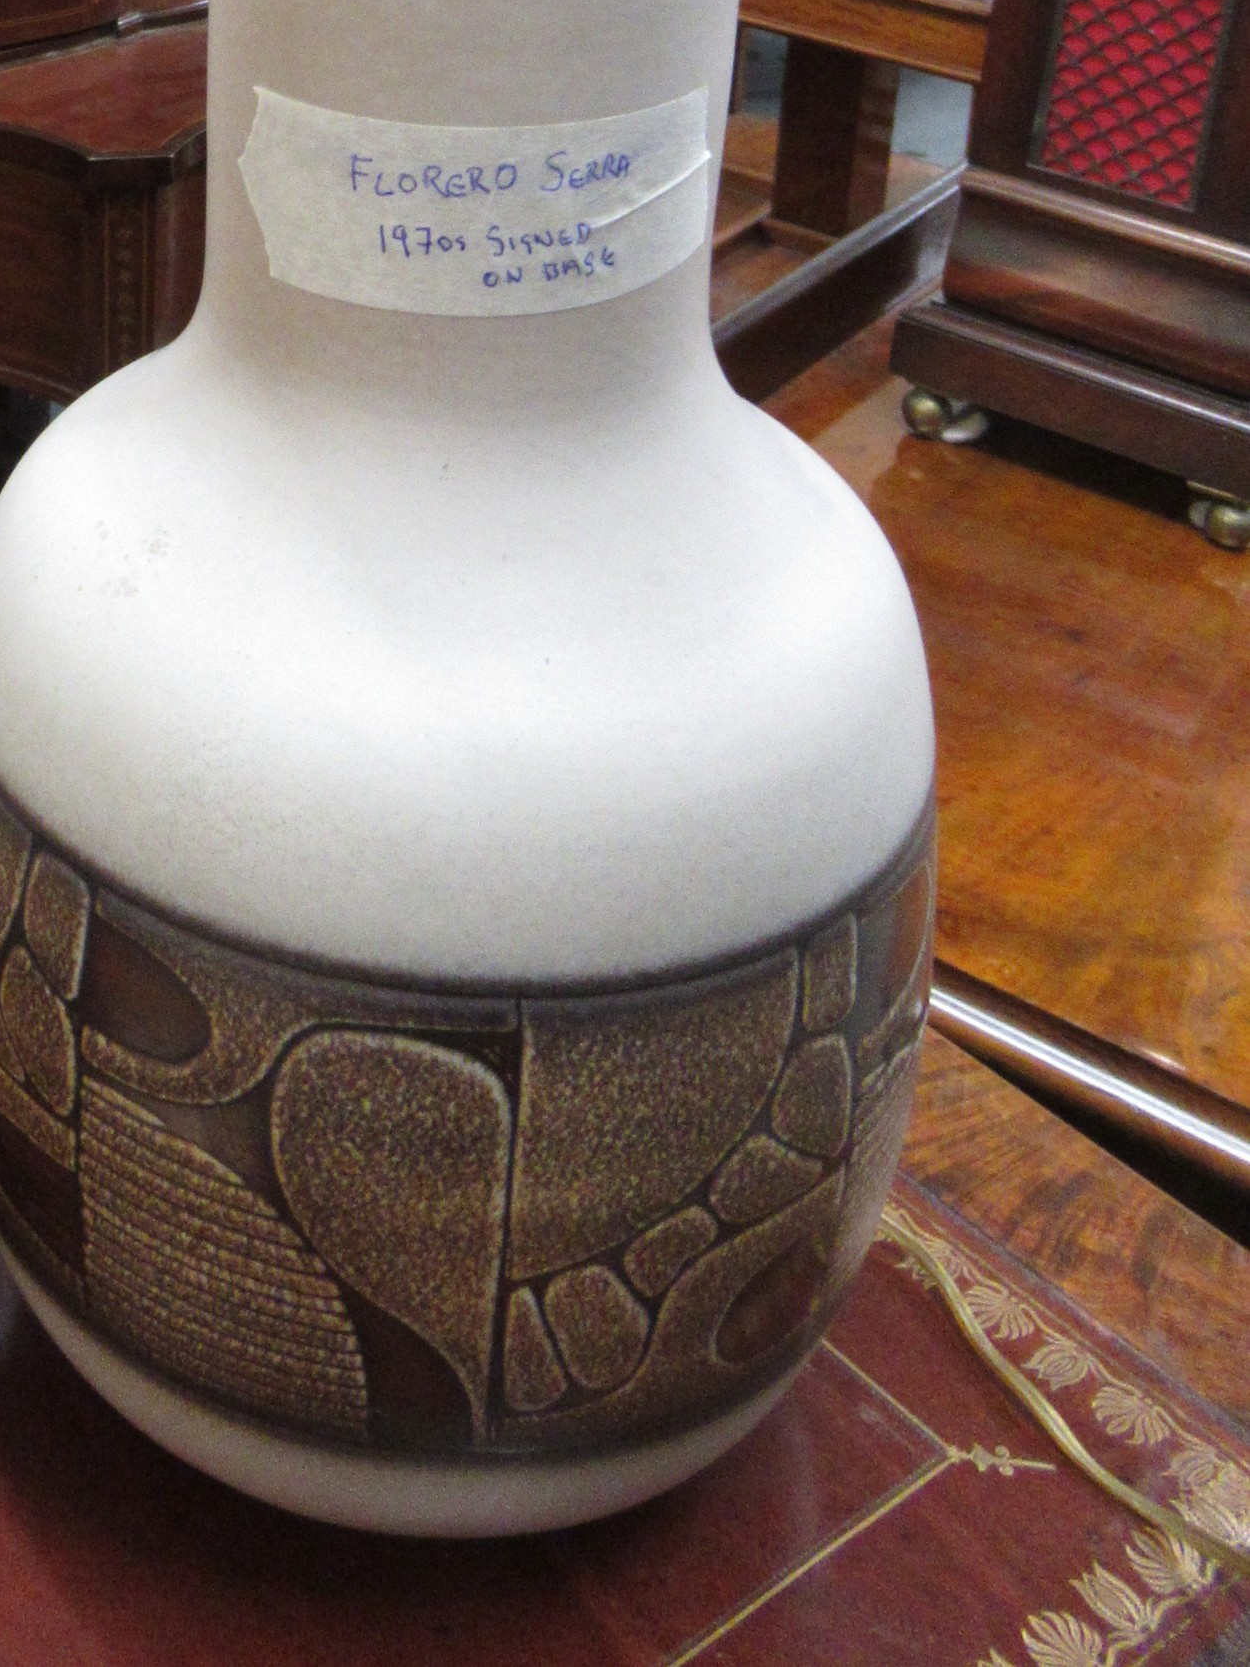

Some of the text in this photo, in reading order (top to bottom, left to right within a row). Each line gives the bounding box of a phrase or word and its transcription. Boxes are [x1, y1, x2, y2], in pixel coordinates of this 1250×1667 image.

[351, 150, 633, 198] FLORERO SERRA
[486, 222, 591, 257] SIGNED
[482, 245, 616, 288] ON BASE
